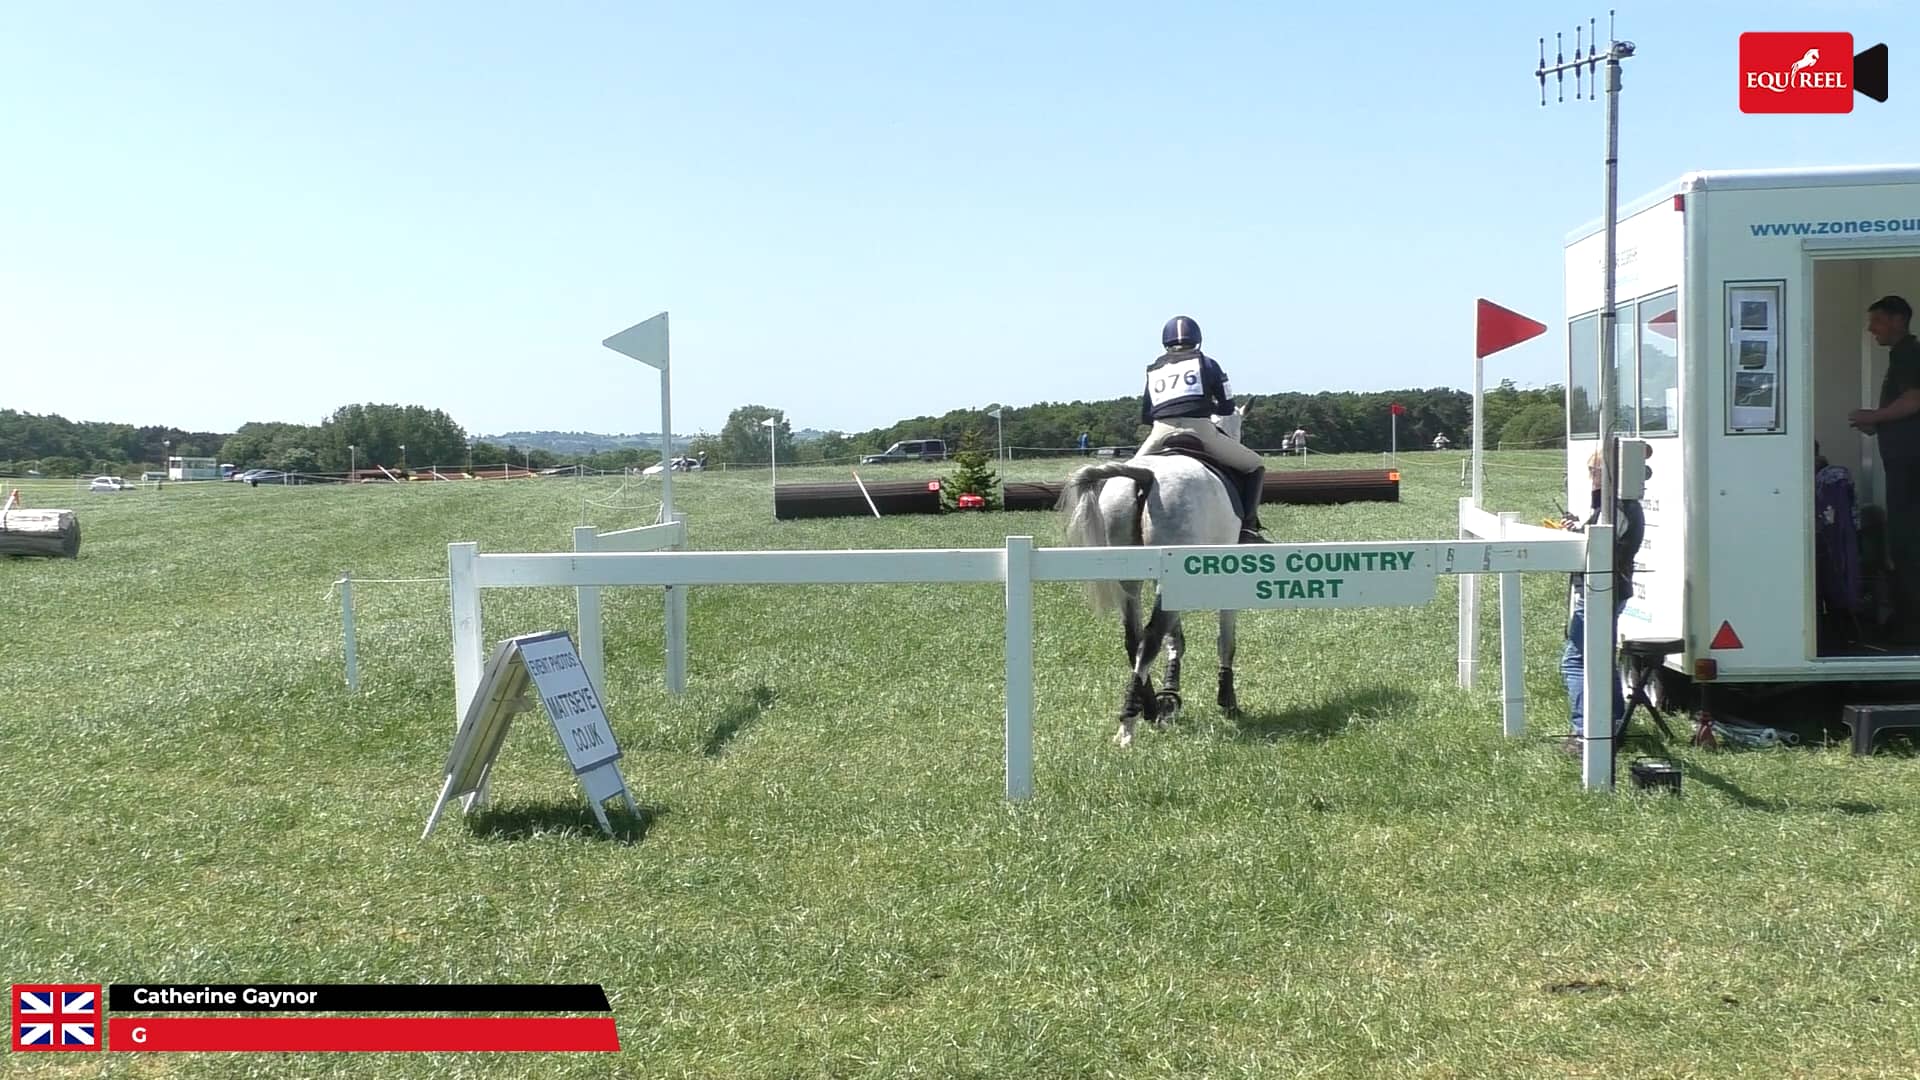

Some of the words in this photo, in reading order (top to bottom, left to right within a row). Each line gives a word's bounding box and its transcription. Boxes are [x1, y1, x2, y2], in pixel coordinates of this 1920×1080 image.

[1154, 370, 1197, 393] 076
[1184, 554, 1275, 575] CROSS
[1286, 551, 1415, 573] COUNTRY
[1256, 579, 1343, 599] START
[528, 658, 552, 676] EVENT
[546, 688, 597, 720] MATTSEYE
[571, 722, 604, 752] .CO.UK
